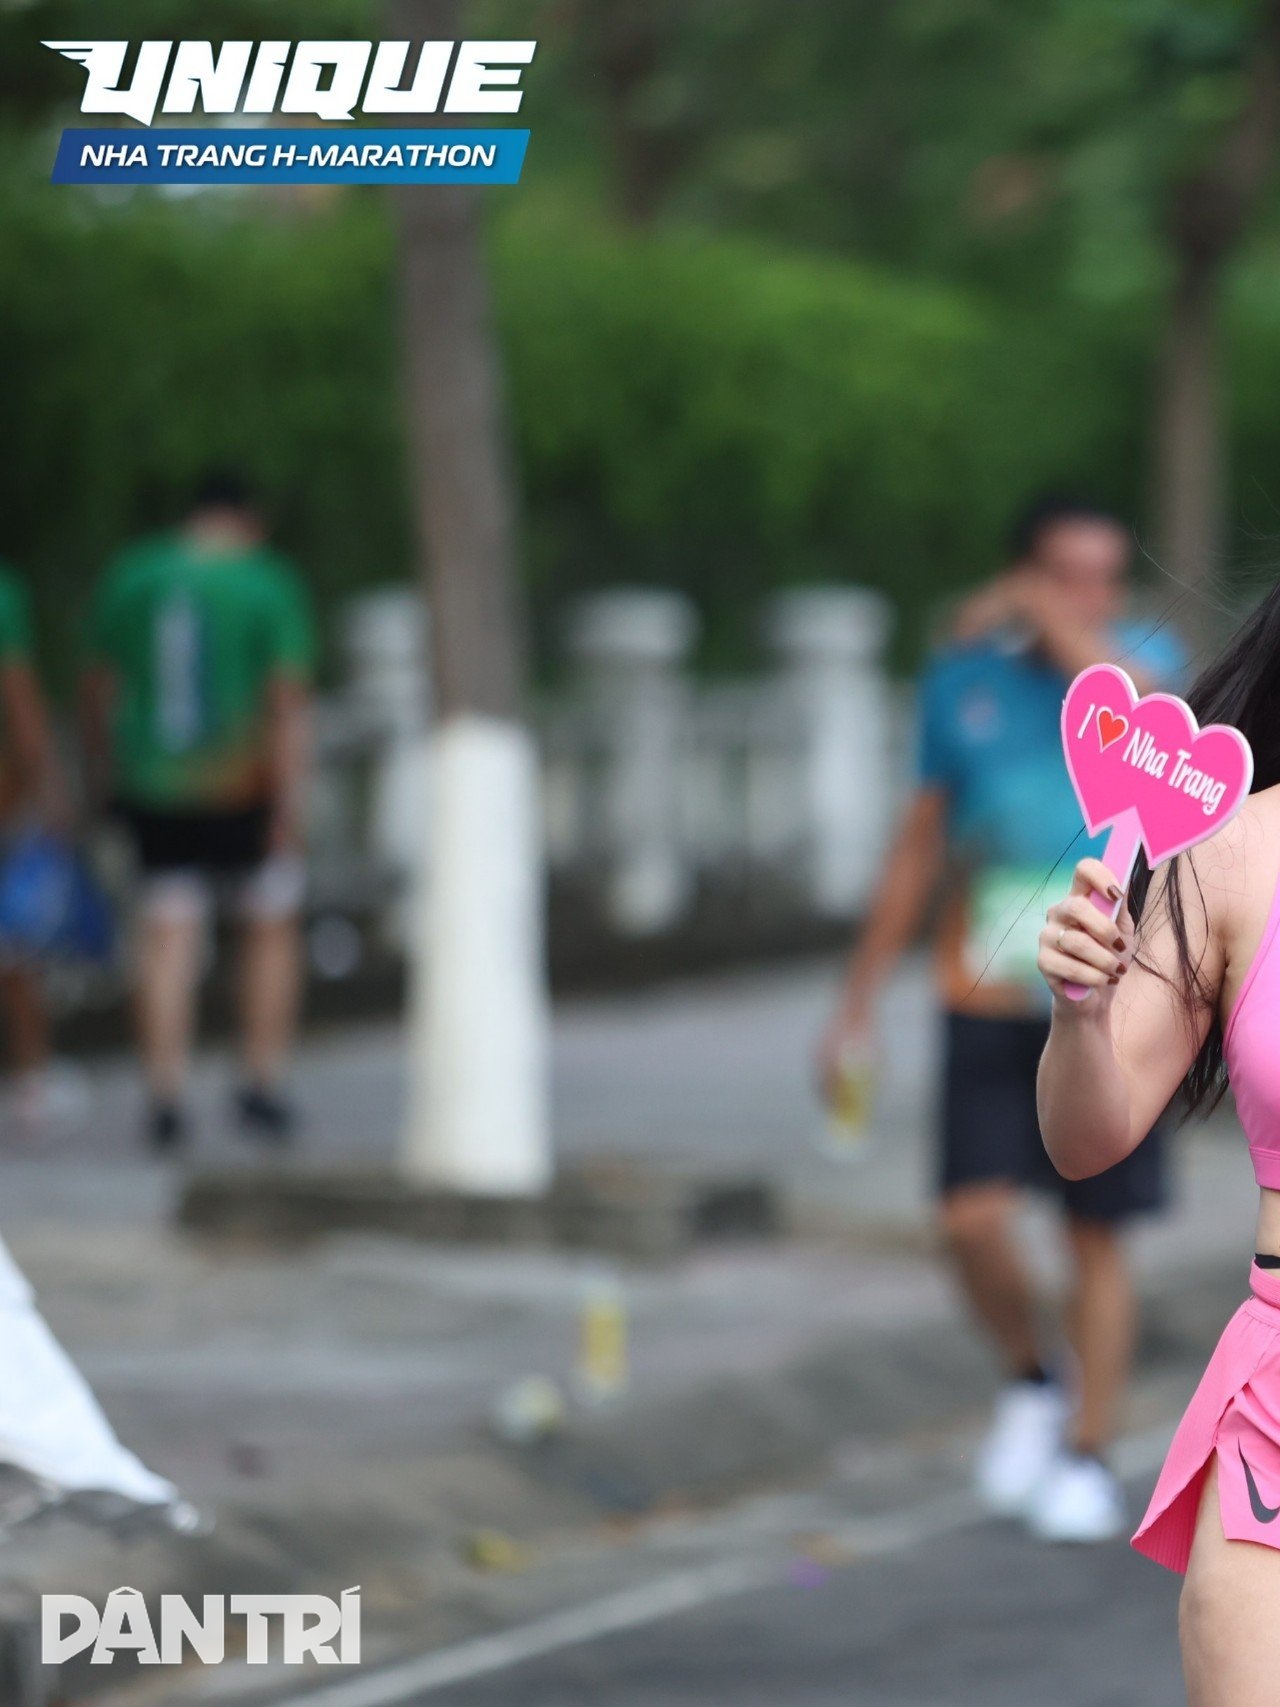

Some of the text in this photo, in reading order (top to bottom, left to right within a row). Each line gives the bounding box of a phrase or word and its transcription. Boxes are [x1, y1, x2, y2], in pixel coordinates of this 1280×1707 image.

[1077, 703, 1228, 816] I Nha Trang
